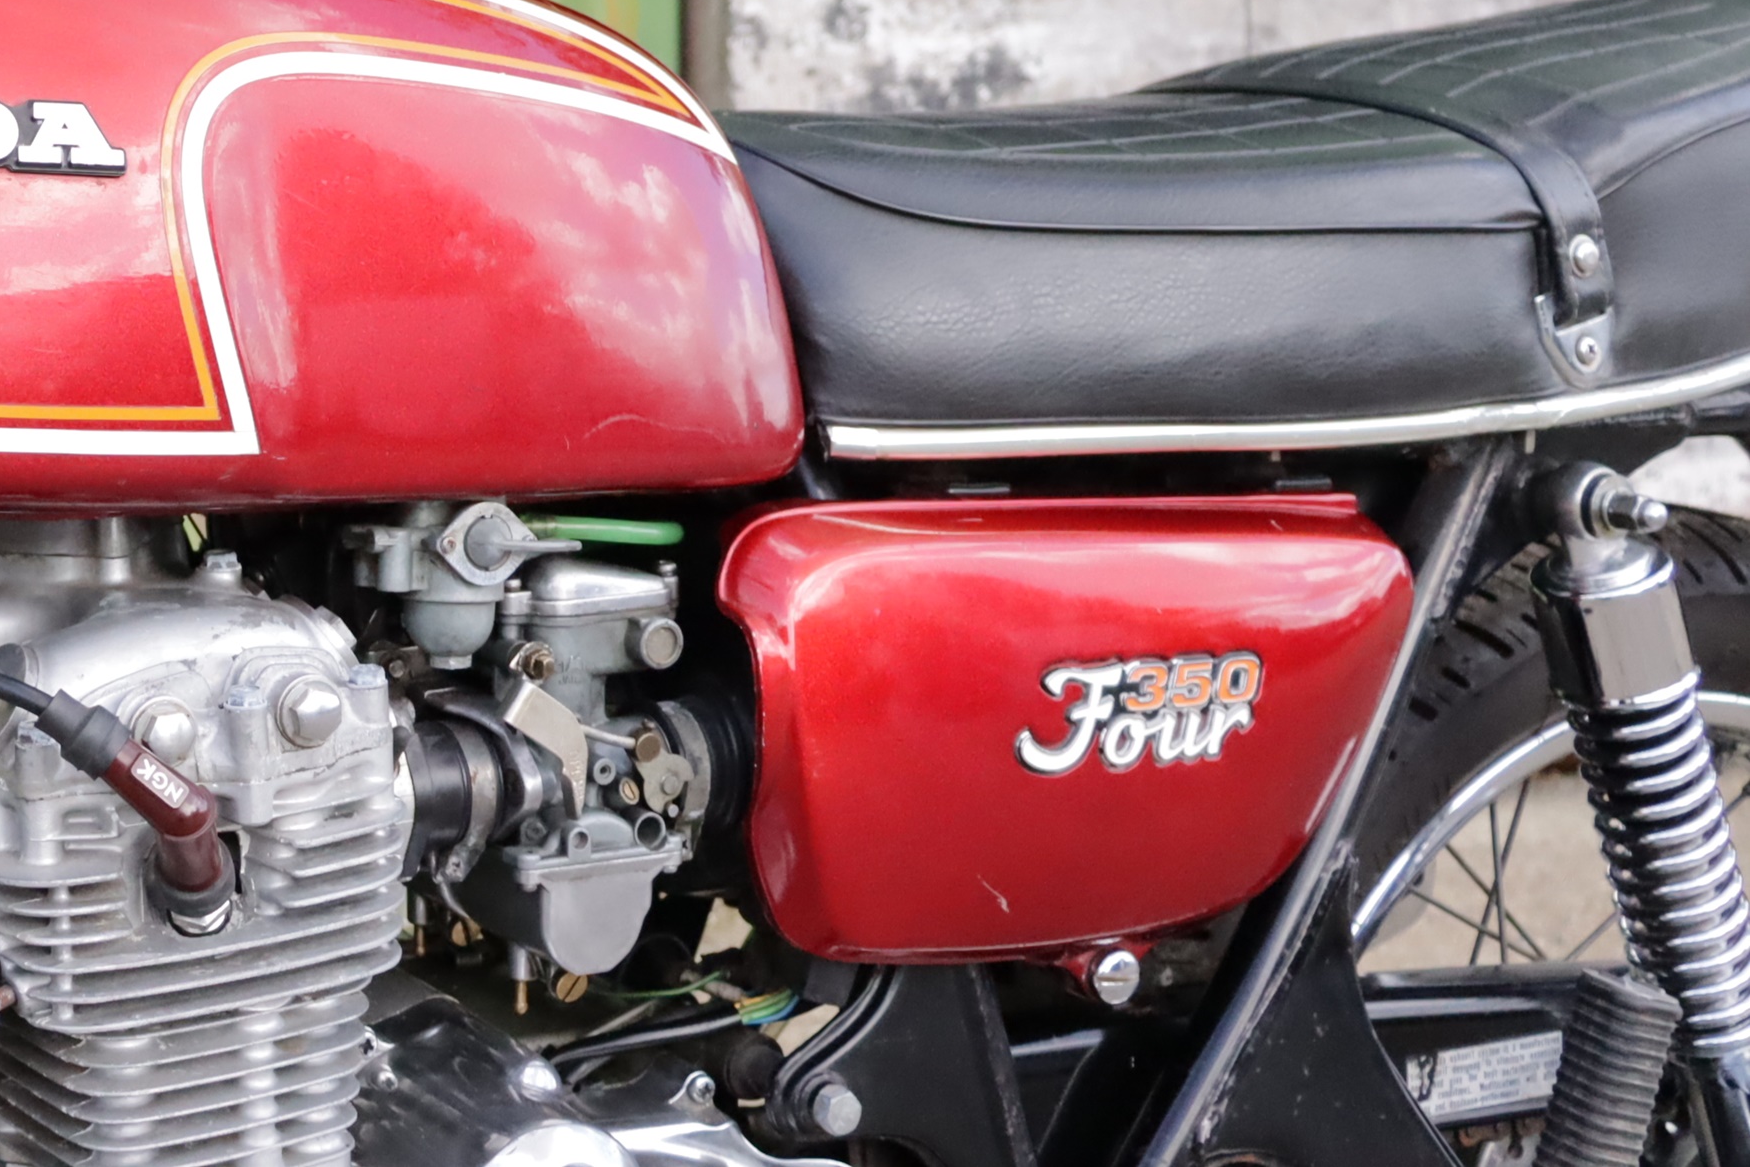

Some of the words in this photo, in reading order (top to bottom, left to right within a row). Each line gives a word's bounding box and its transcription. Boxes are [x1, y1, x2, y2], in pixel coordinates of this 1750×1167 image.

[1121, 653, 1263, 711] 350
[1015, 660, 1253, 774] Four
[136, 757, 185, 803] NGK
